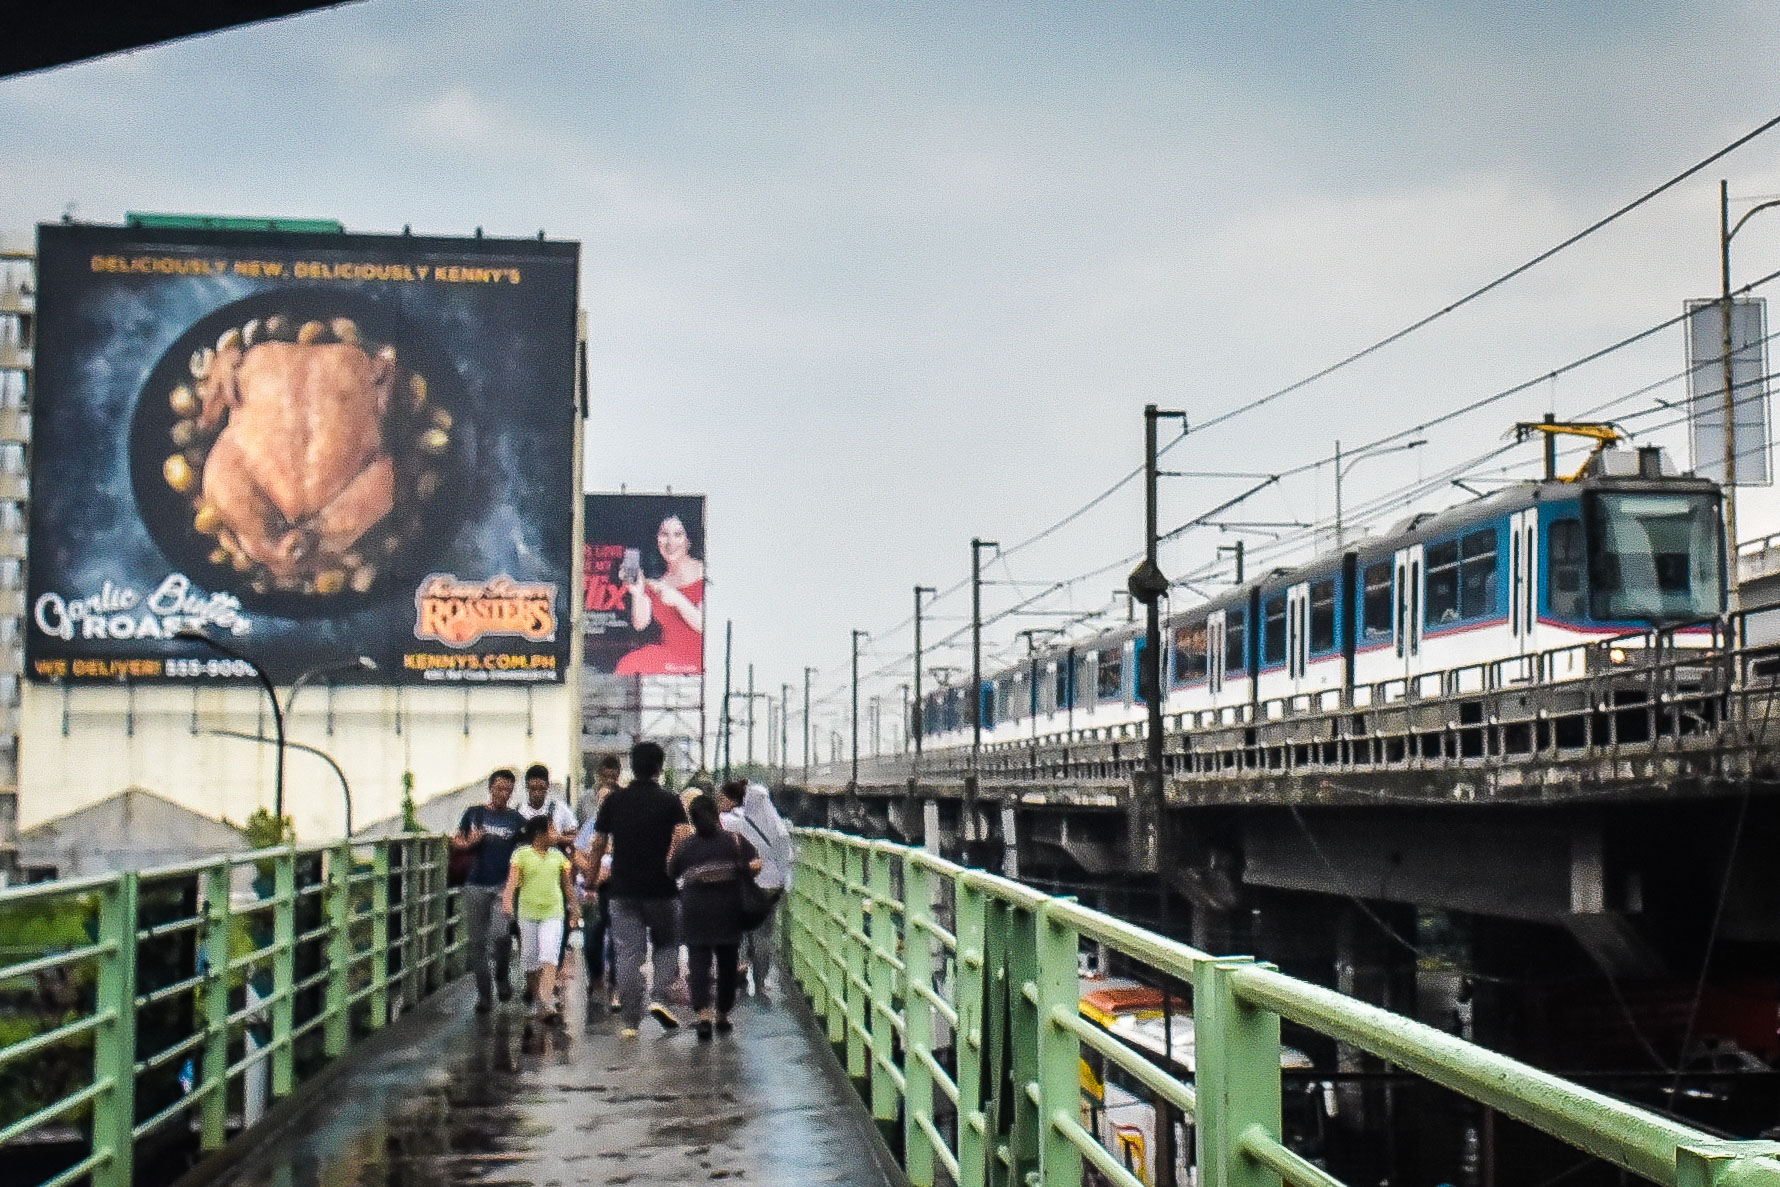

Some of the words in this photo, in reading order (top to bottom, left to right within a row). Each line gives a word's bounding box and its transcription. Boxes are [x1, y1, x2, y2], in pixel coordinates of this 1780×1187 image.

[90, 255, 227, 274] DELICIOUSLY
[294, 261, 429, 281] DELICIOUSLY
[434, 265, 521, 284] KENNY'S
